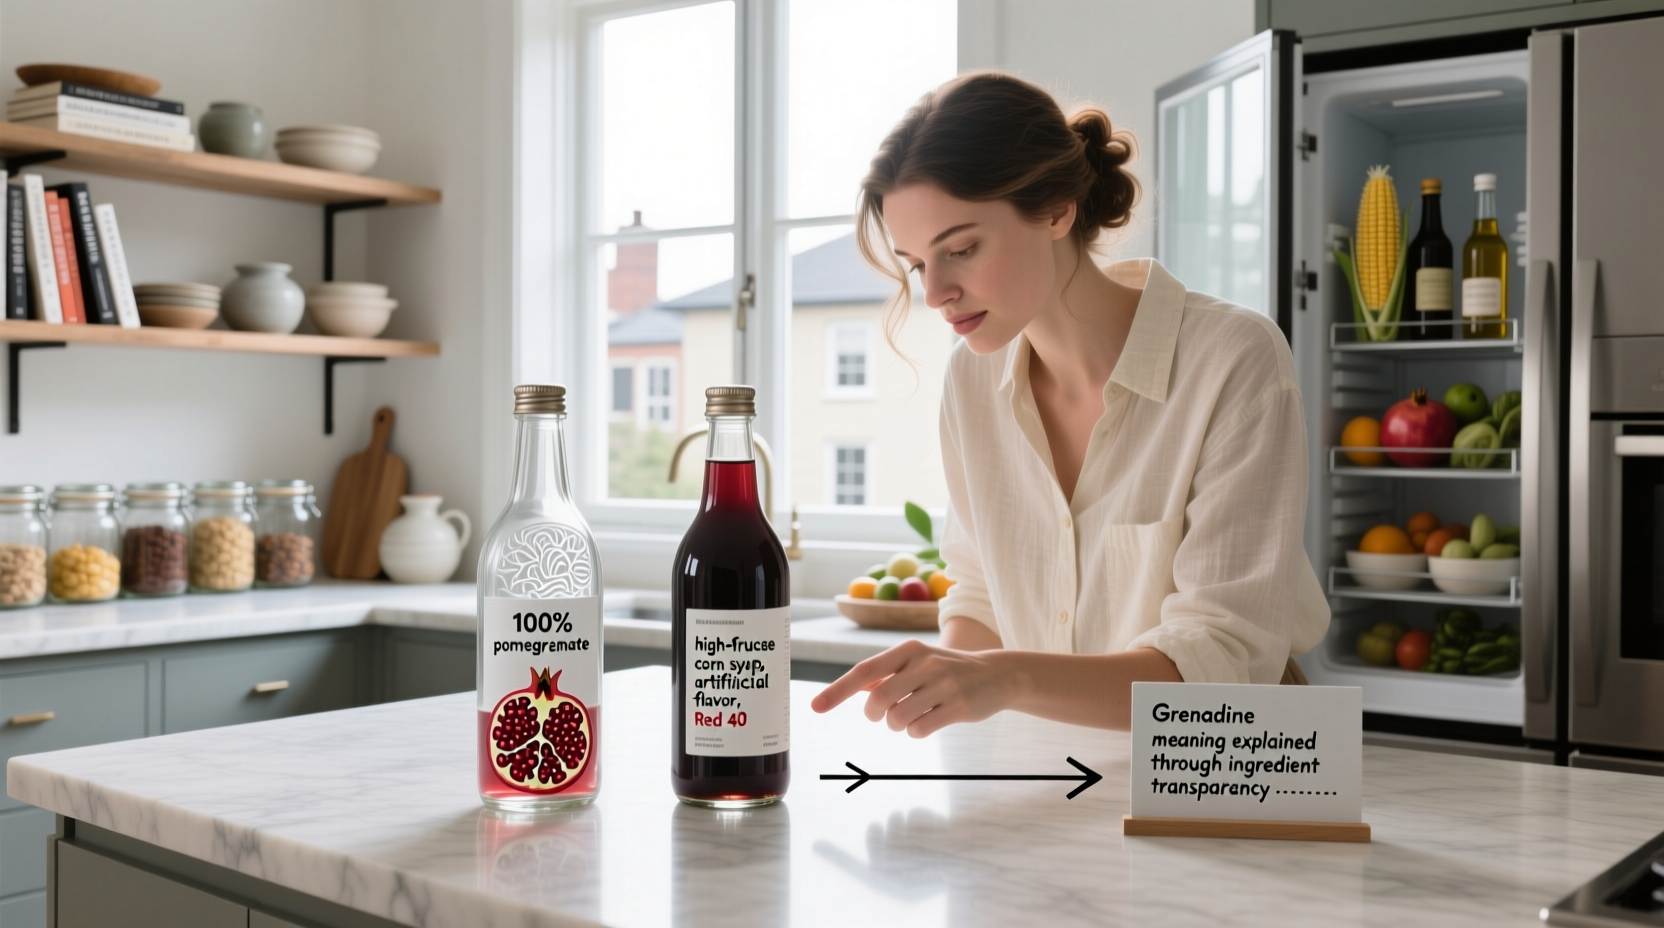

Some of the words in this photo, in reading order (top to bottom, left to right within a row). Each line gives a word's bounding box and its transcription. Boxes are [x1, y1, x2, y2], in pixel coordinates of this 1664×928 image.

[513, 612, 572, 633] 100%
[695, 660, 725, 671] corn
[692, 691, 741, 709] flavor,
[695, 711, 723, 727] Red
[727, 711, 747, 727] 40
[1152, 703, 1255, 724] Grenadine
[1152, 732, 1226, 754] meaning
[1232, 731, 1317, 754] explained
[1151, 753, 1222, 777] through
[1228, 754, 1320, 778] ingredient
